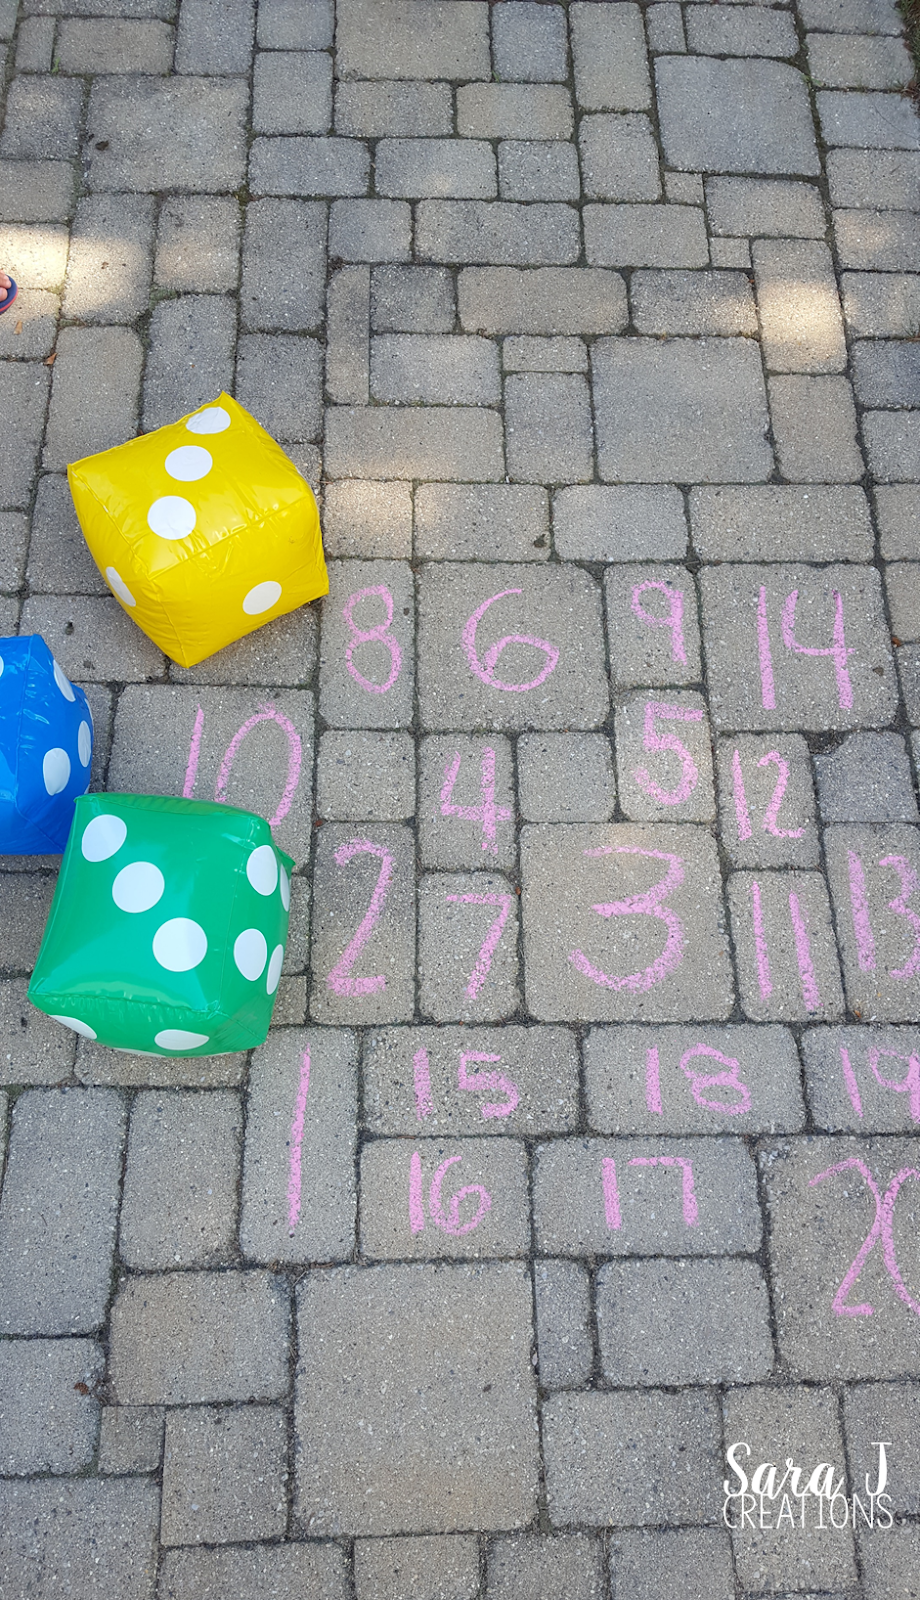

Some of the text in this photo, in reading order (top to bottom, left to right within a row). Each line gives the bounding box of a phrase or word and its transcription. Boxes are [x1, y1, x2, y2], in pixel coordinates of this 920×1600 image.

[344, 586, 403, 694] 8
[463, 588, 560, 693] 6
[631, 580, 688, 666] 9
[758, 586, 856, 711] 14
[182, 703, 303, 827] 10
[441, 747, 511, 855] 4
[634, 702, 704, 806] 5
[732, 749, 806, 841] 12
[327, 838, 394, 998] 2
[446, 894, 512, 1000] 7
[569, 846, 686, 995] 3
[751, 881, 825, 1012] 11
[848, 850, 920, 980] 13
[413, 1047, 520, 1121] 15
[646, 1043, 752, 1116] 18
[840, 1046, 920, 1124] 19
[287, 1046, 312, 1228] 1
[409, 1152, 492, 1237] 16
[603, 1158, 699, 1230] 17
